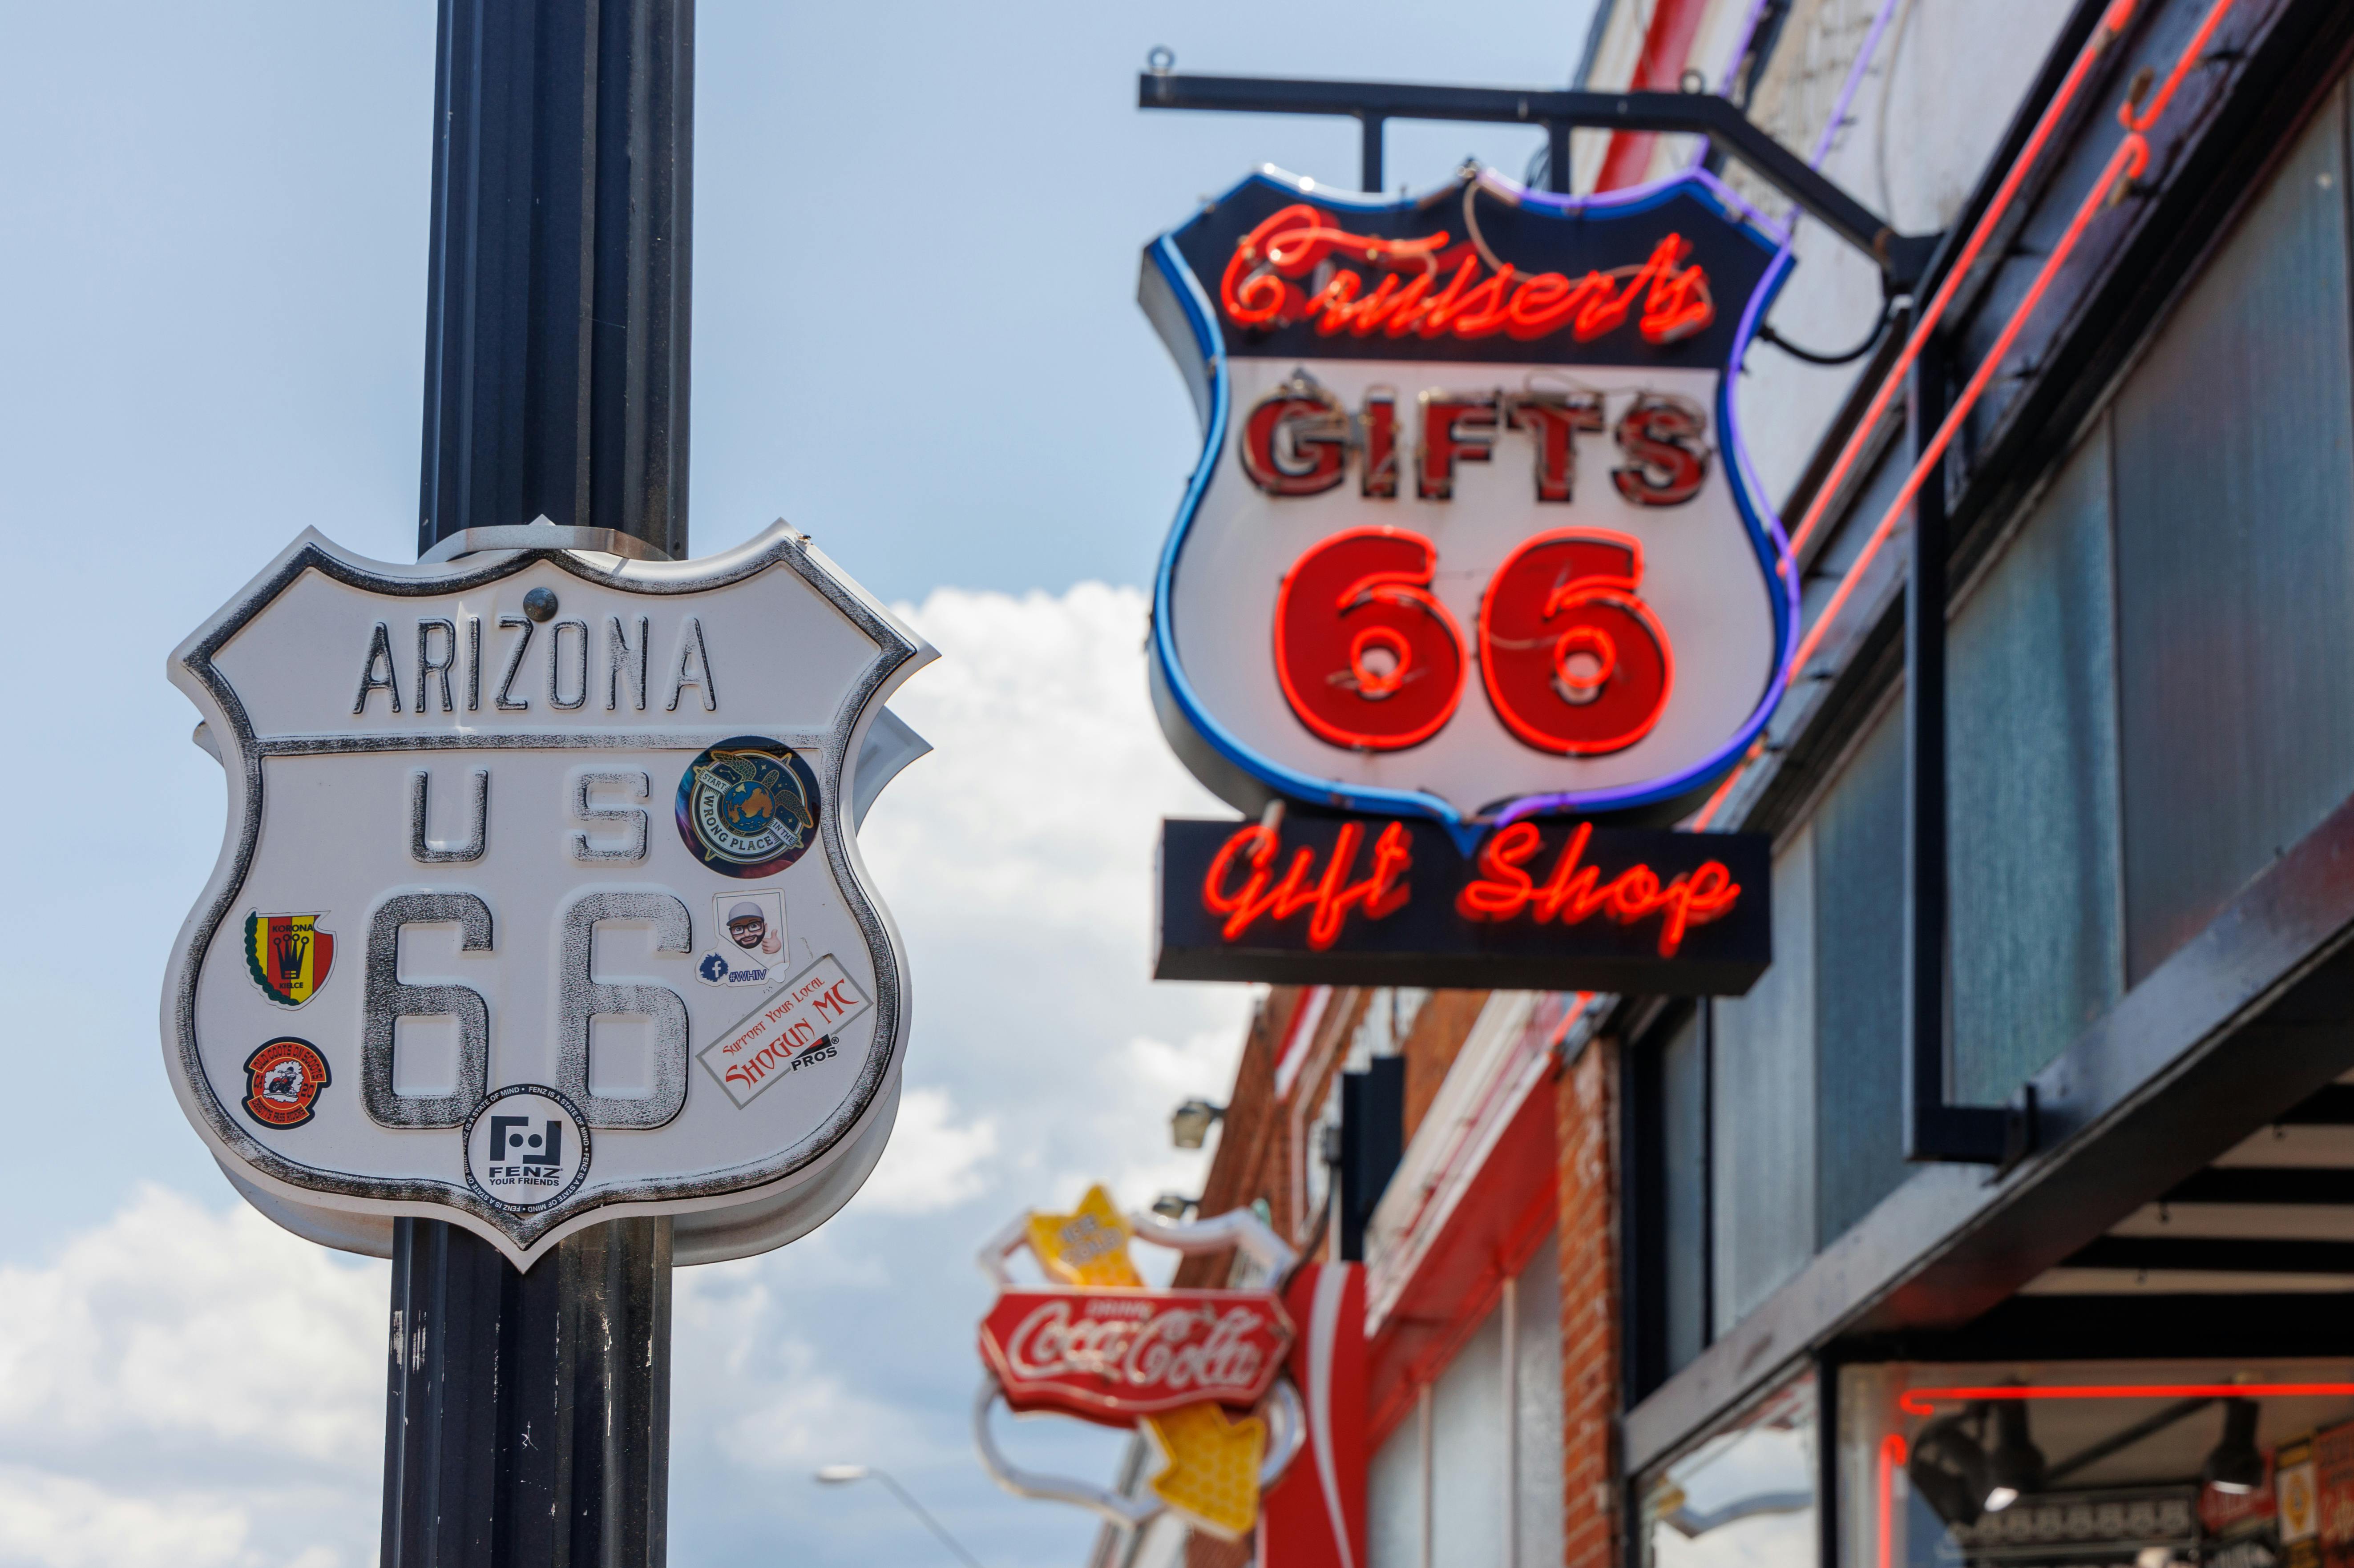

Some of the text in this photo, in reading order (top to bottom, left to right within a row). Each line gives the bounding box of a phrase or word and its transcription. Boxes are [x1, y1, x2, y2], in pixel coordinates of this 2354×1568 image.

[1241, 386, 1709, 506] GIFTS
[1273, 525, 1675, 756] 66
[352, 616, 717, 714] ARIZONA
[703, 773, 727, 790] START
[704, 795, 773, 851] WRONG PLACE
[772, 822, 794, 843] IN THE
[1203, 821, 1740, 958] Gift Shop
[272, 924, 314, 932] KORONA
[728, 969, 767, 983] #WHIV
[359, 891, 692, 1130] 66
[723, 977, 825, 1056] SUPPORT YOUR LOCAL
[726, 978, 859, 1090] SHOGUN MC
[254, 1045, 323, 1080] OLD COOTS ON SCOOTS
[791, 1047, 837, 1072] PROS
[301, 1083, 314, 1098] 20
[472, 1099, 491, 1117] STATE
[490, 1092, 500, 1101] OF
[500, 1087, 520, 1096] MIND
[529, 1086, 548, 1095] FENZ
[561, 1099, 578, 1117] STATE
[575, 1117, 584, 1125] OF
[580, 1127, 589, 1146] MIND
[489, 1166, 560, 1179] FENZ
[581, 1153, 589, 1172] FENZ
[466, 1175, 474, 1184] OF
[518, 1178, 559, 1186] FRIENDS
[577, 1172, 584, 1180] IS
[472, 1184, 489, 1201] STATE
[557, 1185, 576, 1202] STATE
[528, 1203, 547, 1212] MIND
[548, 1199, 557, 1208] OF
